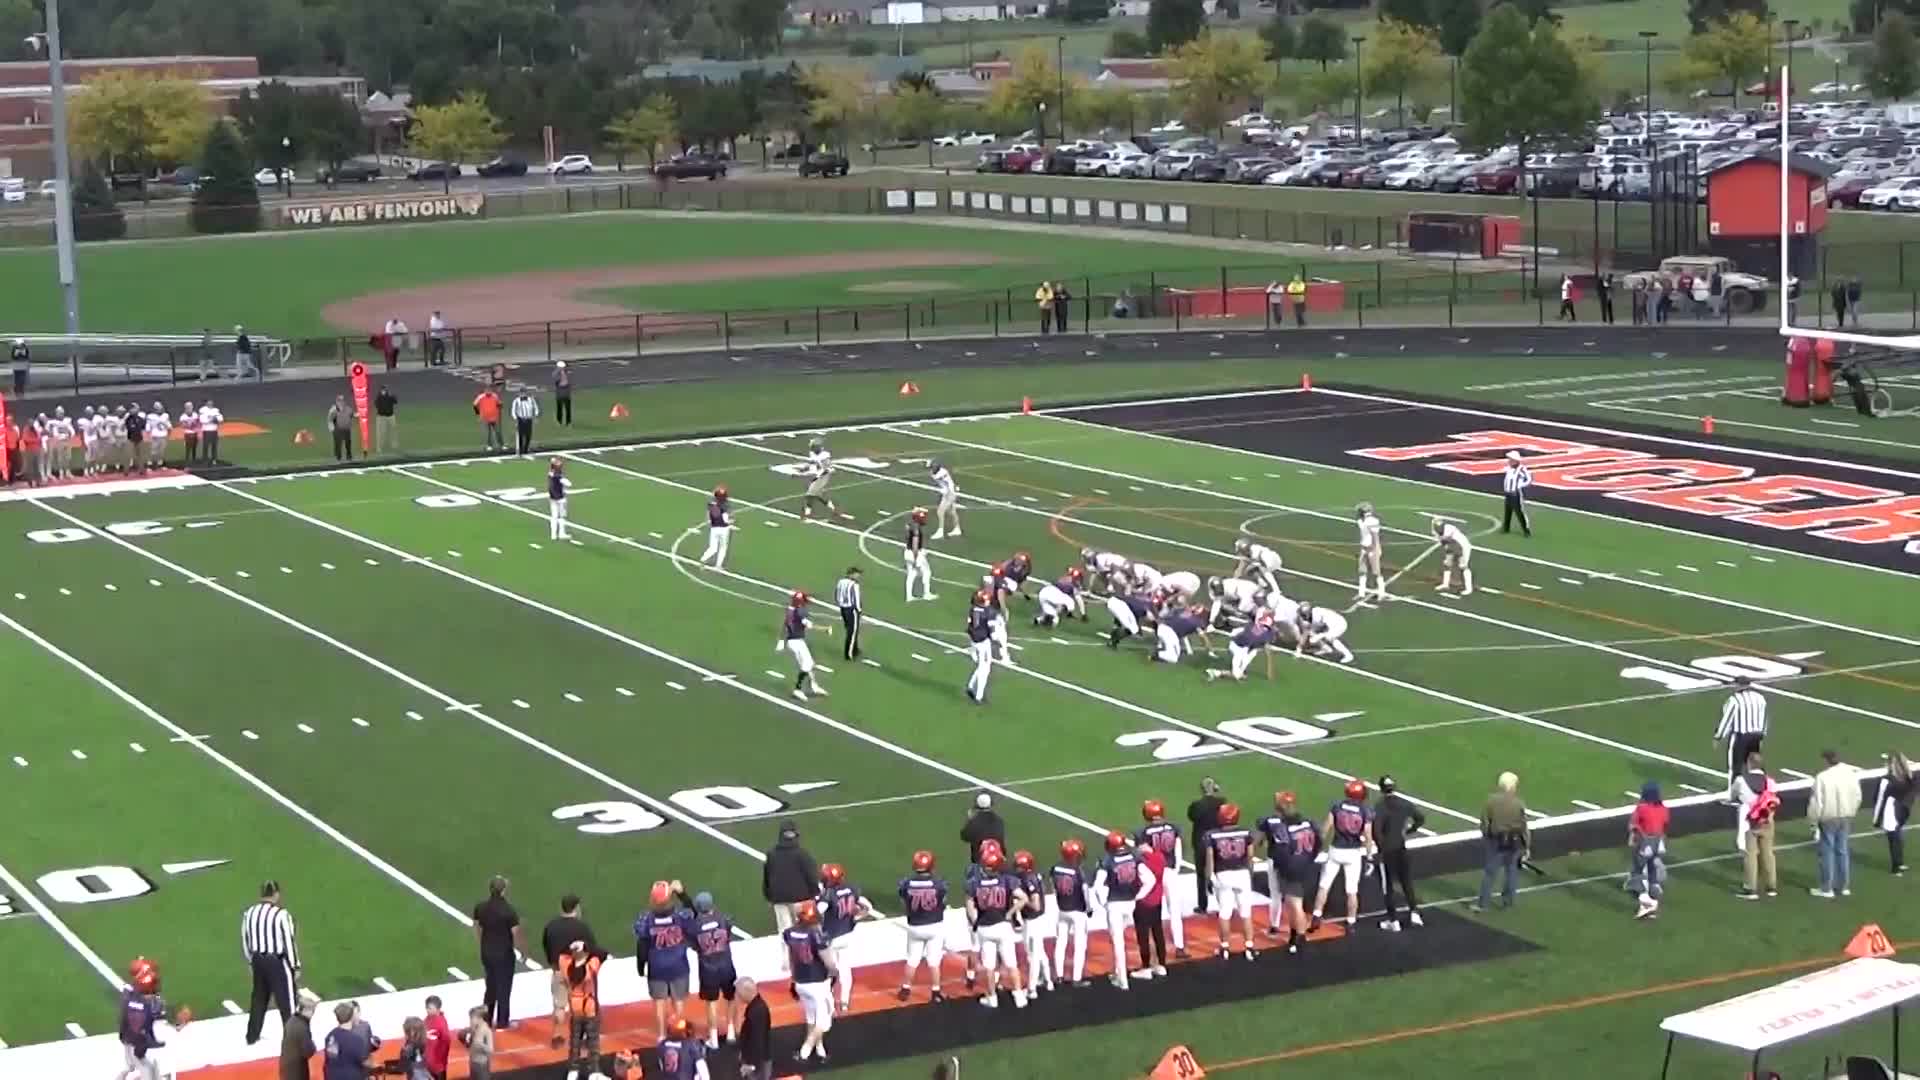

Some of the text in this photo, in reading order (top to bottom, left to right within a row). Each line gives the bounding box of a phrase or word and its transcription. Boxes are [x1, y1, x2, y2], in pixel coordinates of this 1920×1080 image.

[290, 199, 456, 224] WE ARE FENTON!
[1620, 655, 1802, 690] 10
[1114, 716, 1329, 760] 20
[551, 785, 783, 833] 30
